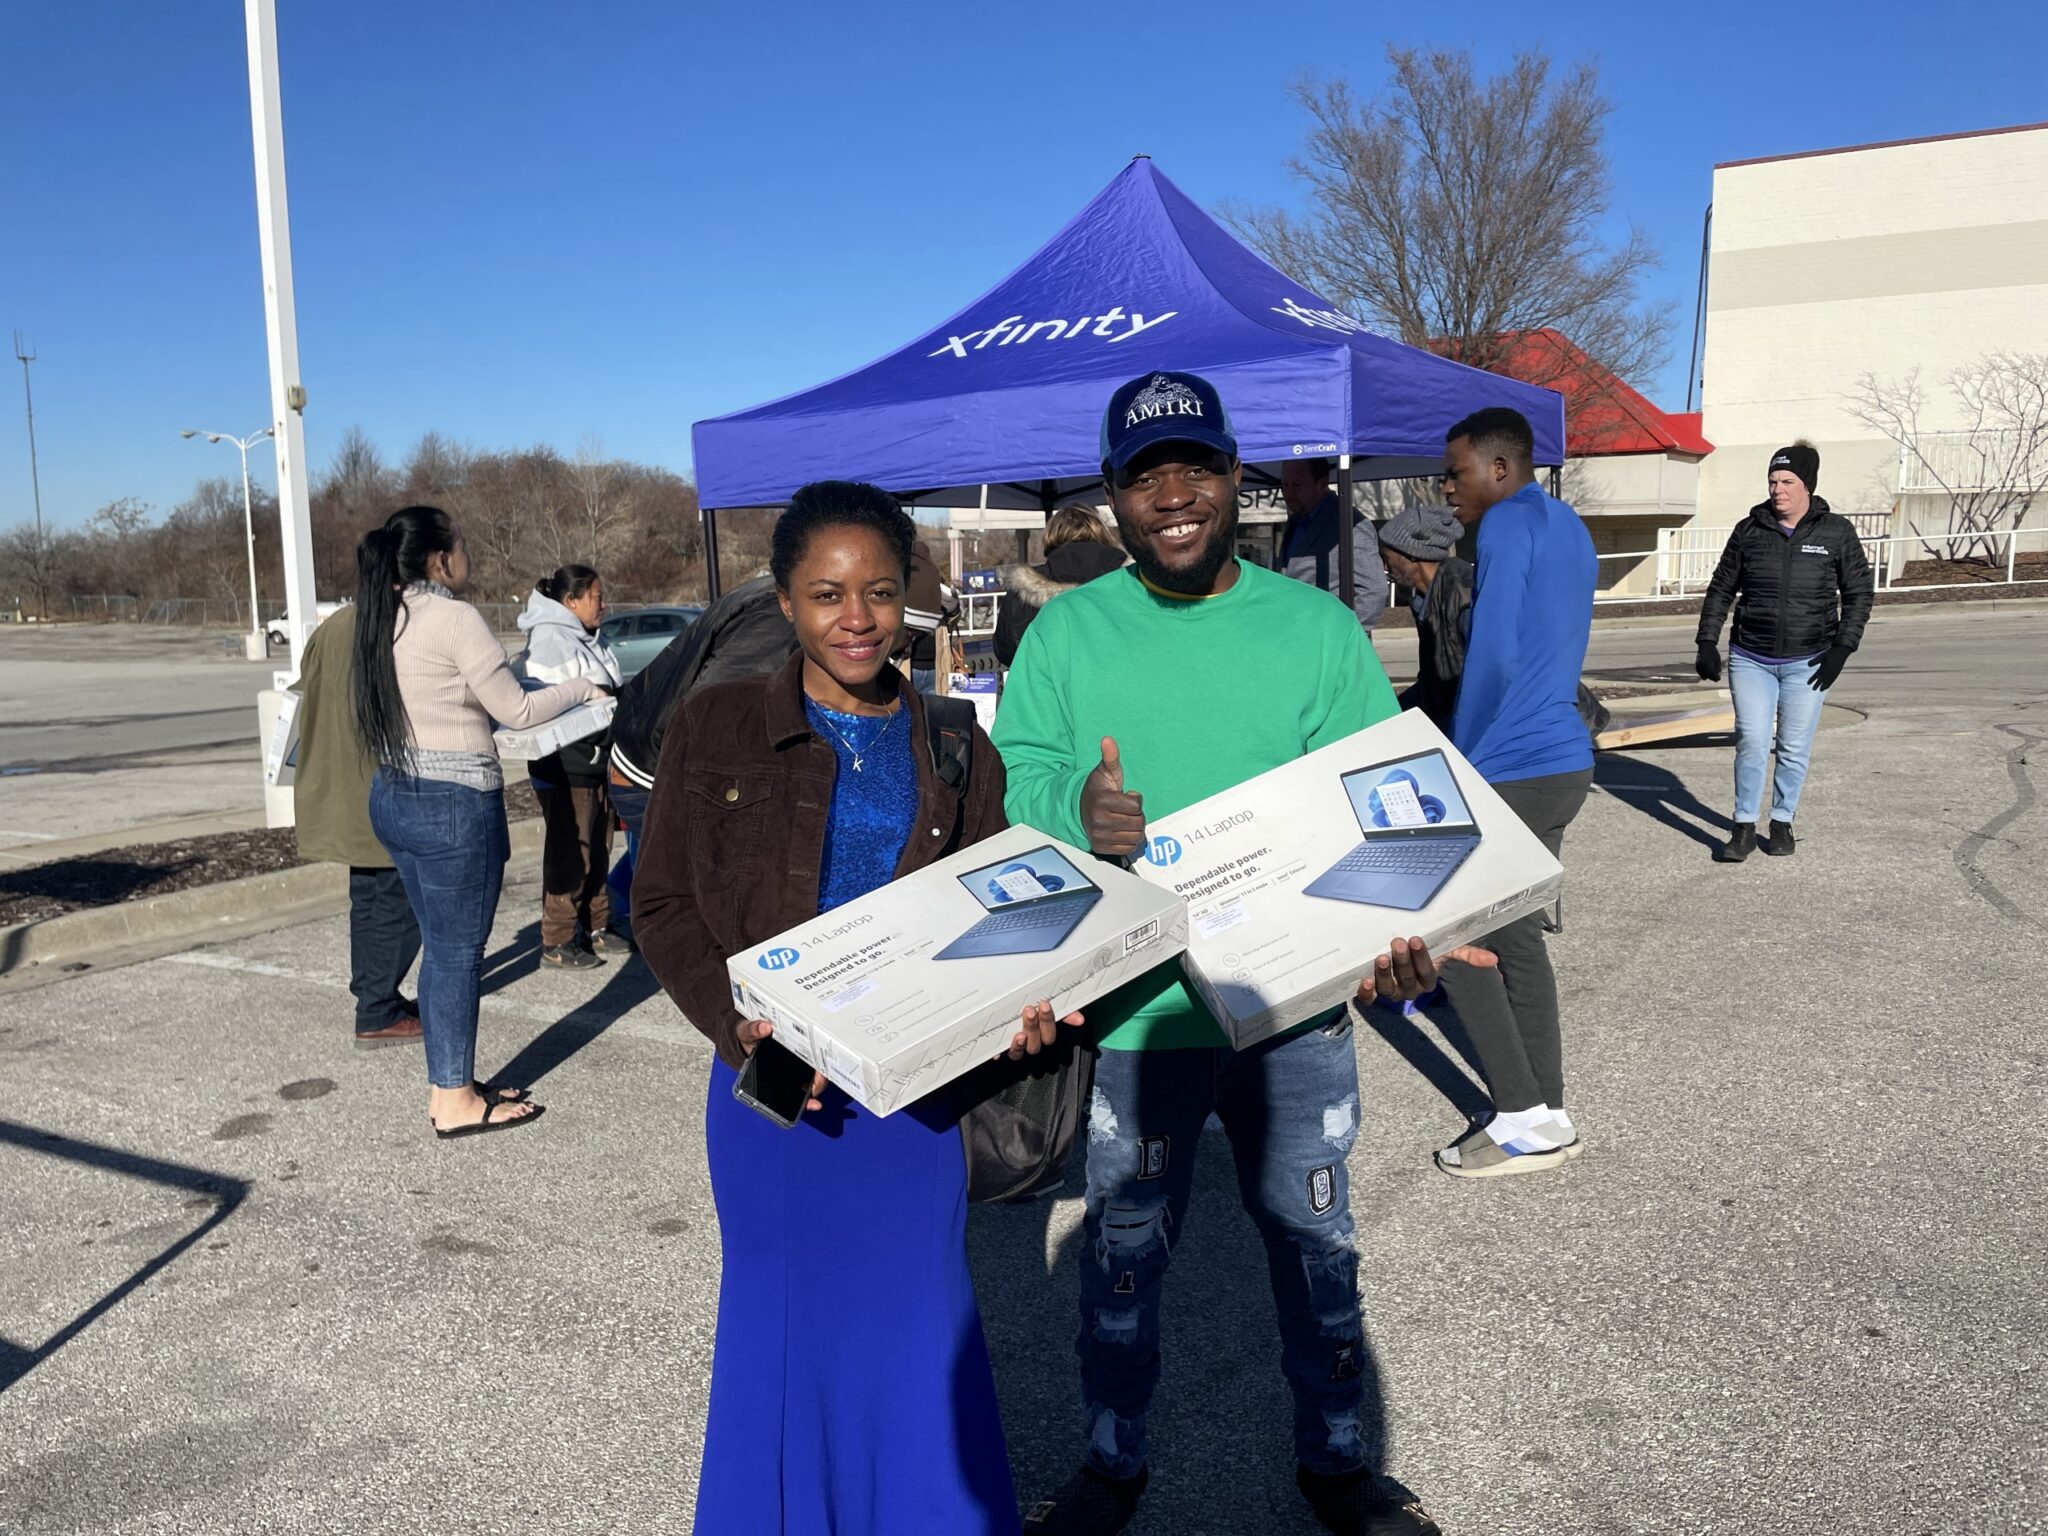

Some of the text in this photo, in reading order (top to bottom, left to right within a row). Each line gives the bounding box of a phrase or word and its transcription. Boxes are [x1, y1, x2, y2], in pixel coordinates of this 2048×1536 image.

[927, 306, 1178, 358] xfinity
[1125, 398, 1204, 429] AMIRI
[1303, 443, 1336, 453] TentCraft
[1184, 809, 1254, 845] 14 Laptop
[1147, 836, 1179, 866] hp
[1174, 846, 1273, 893] Dependable power.
[1182, 866, 1261, 902] Designed to go.
[801, 914, 874, 949] 14 Laptop
[761, 948, 797, 970] hp
[794, 951, 859, 985] Dependable
[859, 935, 896, 955] power.
[803, 950, 886, 991] Designed to go.
